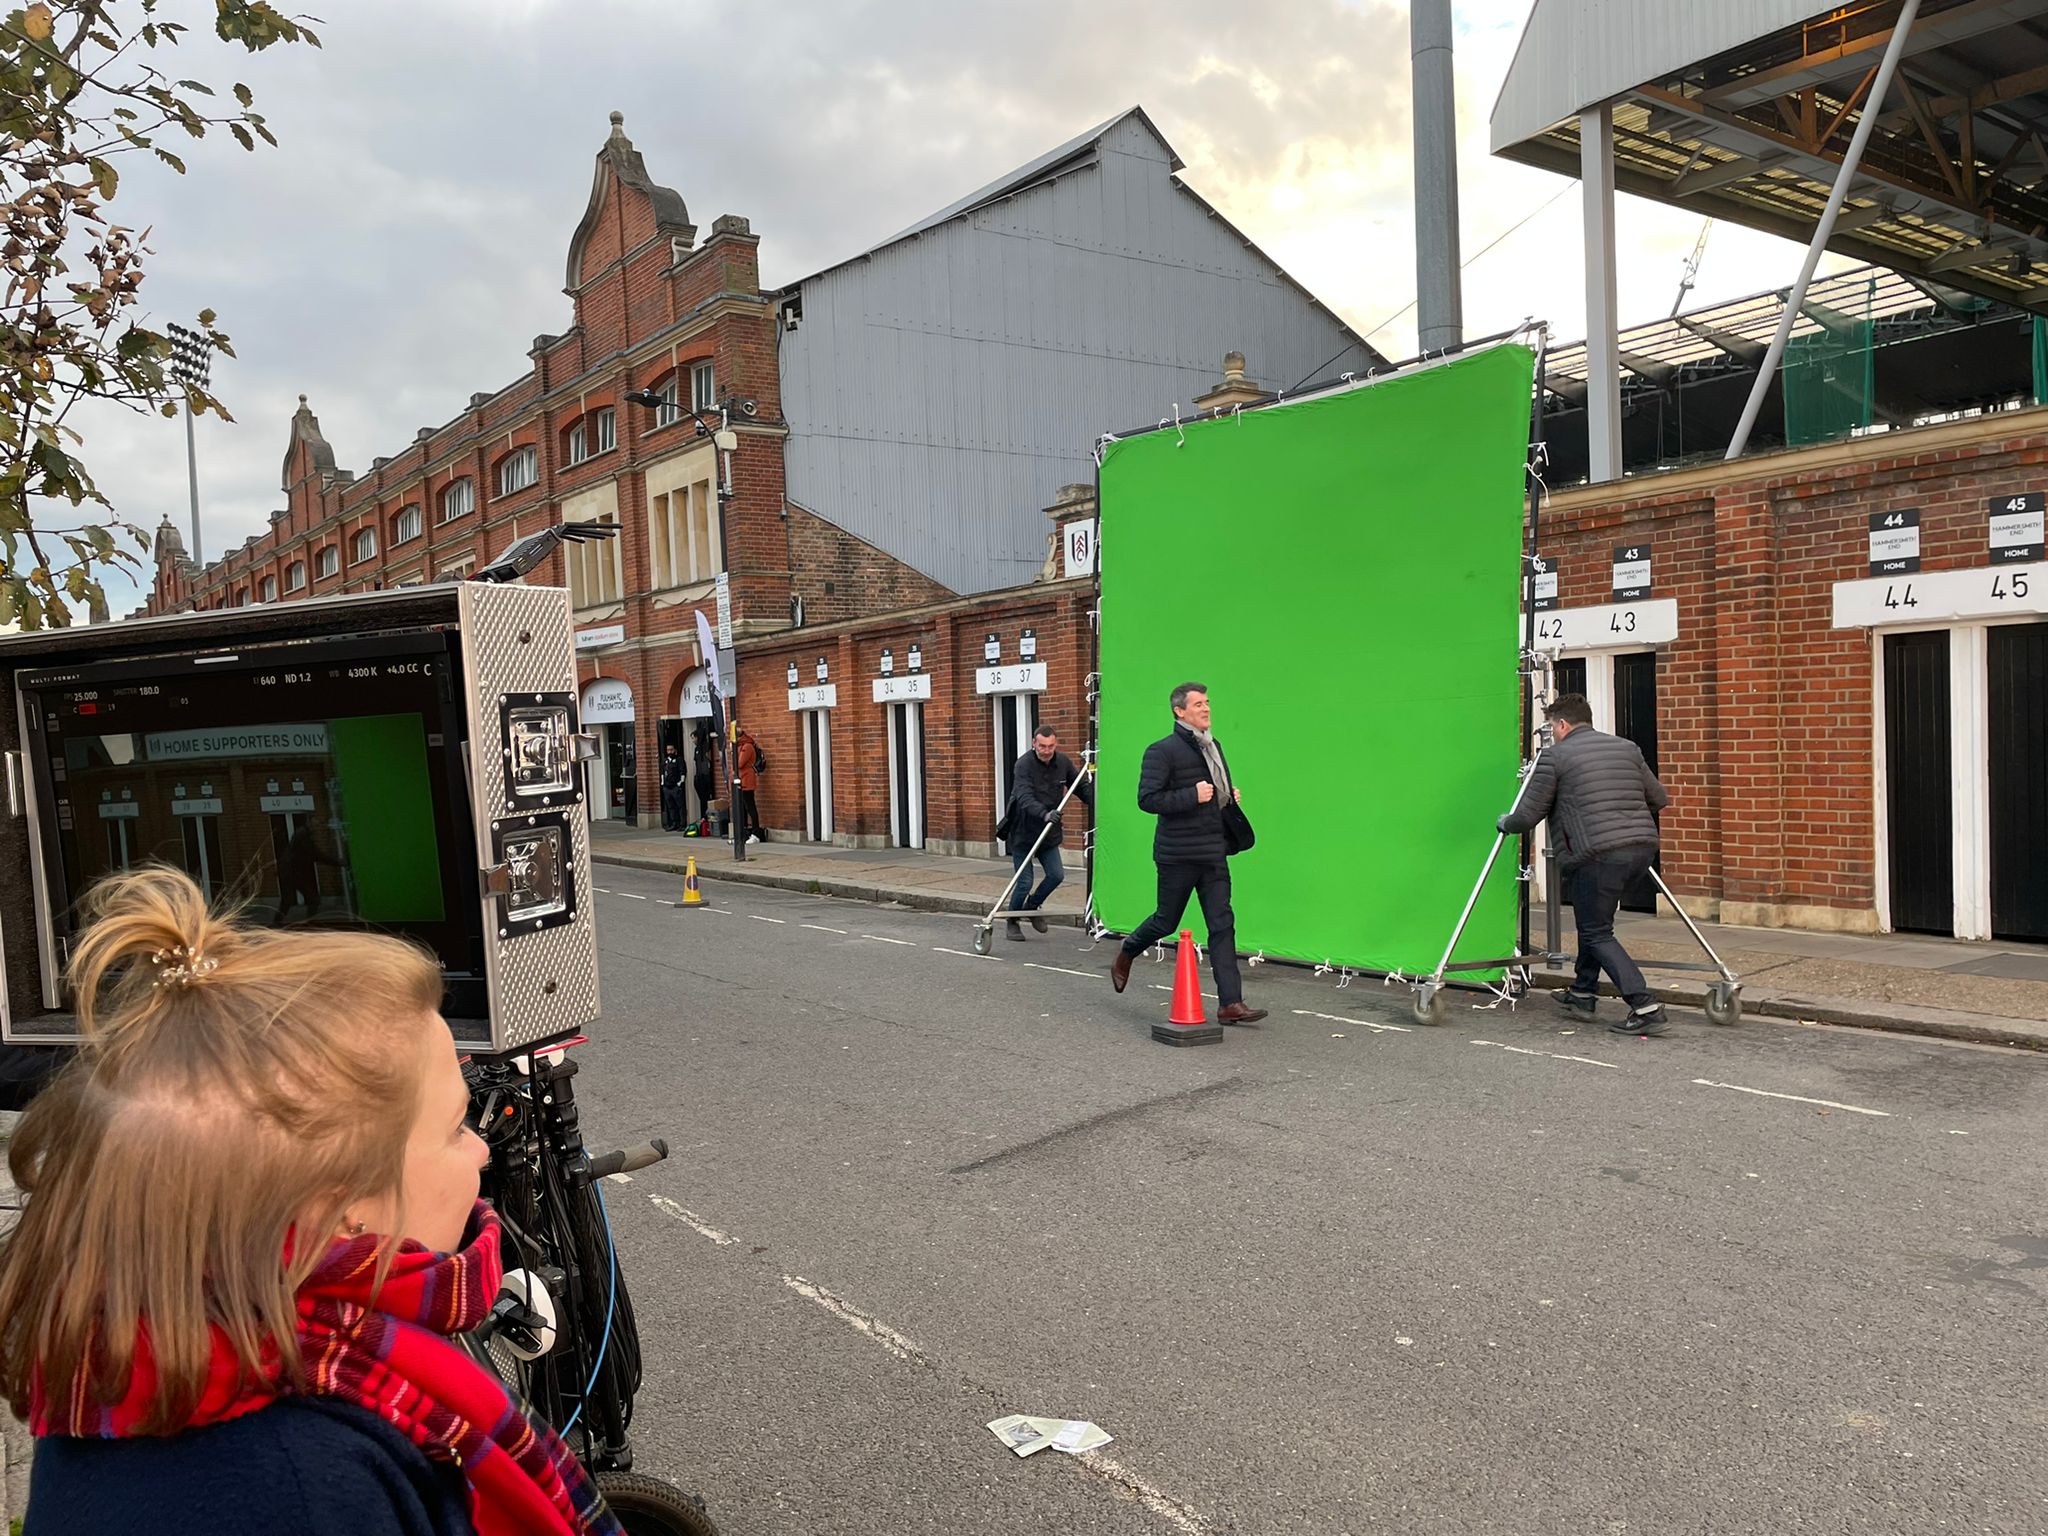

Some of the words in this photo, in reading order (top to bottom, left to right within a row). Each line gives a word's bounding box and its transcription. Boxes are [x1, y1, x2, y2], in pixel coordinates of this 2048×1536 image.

[2006, 497, 2026, 511] 45
[1884, 513, 1904, 526] 44
[1992, 521, 2042, 532] HAMMERSMITH
[1624, 548, 1639, 560] 43
[2004, 548, 2029, 557] HOME
[1883, 561, 1906, 570] HOME
[1622, 589, 1640, 597] HOME
[1884, 584, 1918, 609] 44
[1991, 573, 2029, 600] 45
[1539, 619, 1563, 639] 42
[1610, 611, 1636, 633] 43
[348, 667, 370, 678] 4300
[371, 666, 378, 676] K
[387, 664, 405, 674] +4.0
[407, 663, 418, 673] CC
[260, 676, 276, 686] 640
[285, 673, 297, 684] ND
[299, 672, 311, 682] 1.2
[991, 672, 1001, 685] 36
[1020, 669, 1031, 683] 37
[139, 686, 159, 696] 180.0
[885, 682, 894, 694] 34
[908, 680, 918, 692] 35
[74, 691, 98, 701] 25.000
[164, 739, 200, 754] HOME
[203, 734, 289, 751] SUPPORTERS
[293, 733, 325, 747] ONLY
